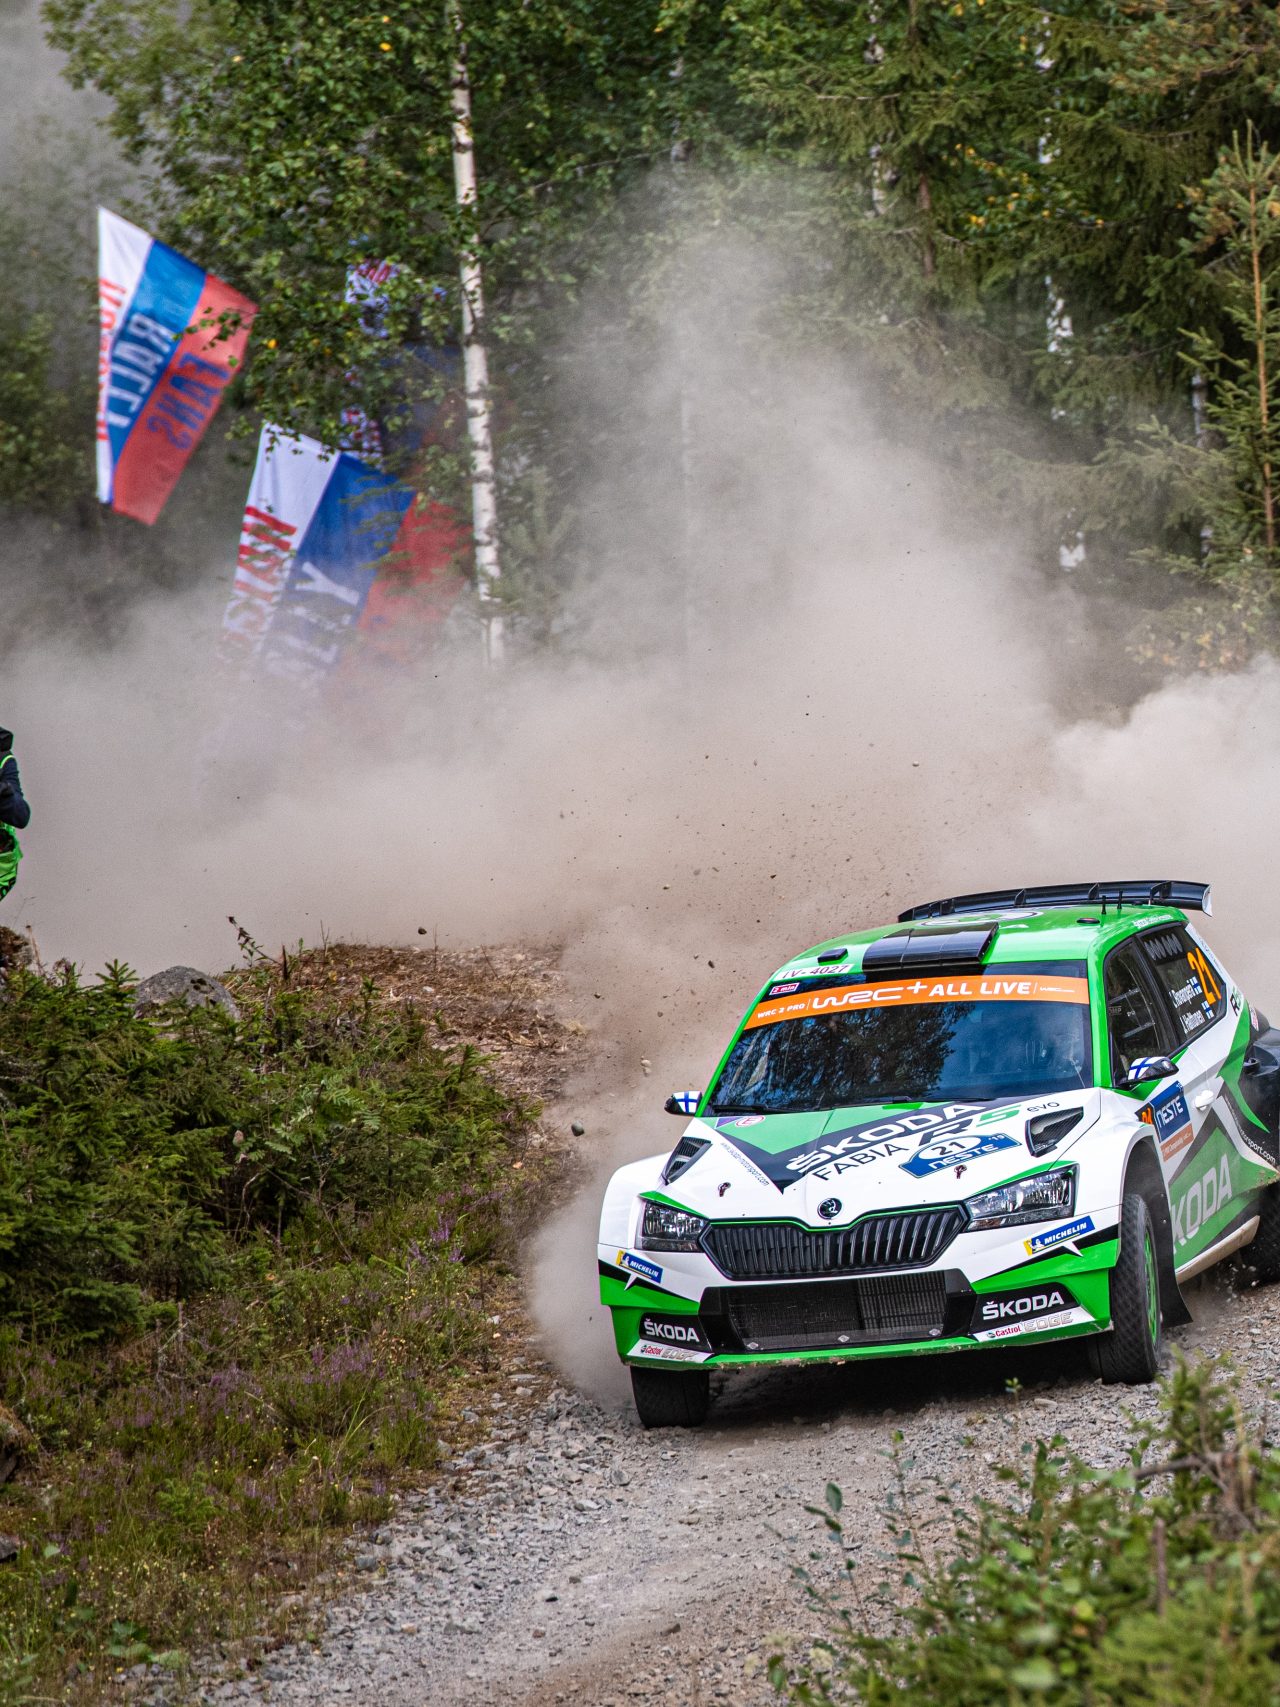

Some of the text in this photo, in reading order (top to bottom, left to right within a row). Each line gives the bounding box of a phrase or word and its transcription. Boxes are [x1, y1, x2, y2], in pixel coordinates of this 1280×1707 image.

[1186, 946, 1222, 1005] 21
[928, 983, 973, 997] ALL
[979, 981, 1031, 995] LIVE
[757, 1009, 777, 1019] WRC
[786, 1003, 806, 1012] PRO
[1156, 1095, 1184, 1128] NESTE
[785, 1104, 988, 1174] ŠKODA
[812, 1143, 911, 1181] FABIA
[1026, 1101, 1060, 1113] evo
[930, 1141, 966, 1156] 21
[928, 1143, 999, 1169] NESTE
[1171, 1153, 1233, 1254] KODA
[1043, 1222, 1088, 1246] MICHELIN
[629, 1259, 660, 1279] MICHELIN
[982, 1291, 1065, 1320] ŠKODA
[644, 1318, 701, 1343] ŠKODA
[995, 1325, 1022, 1337] Castrol
